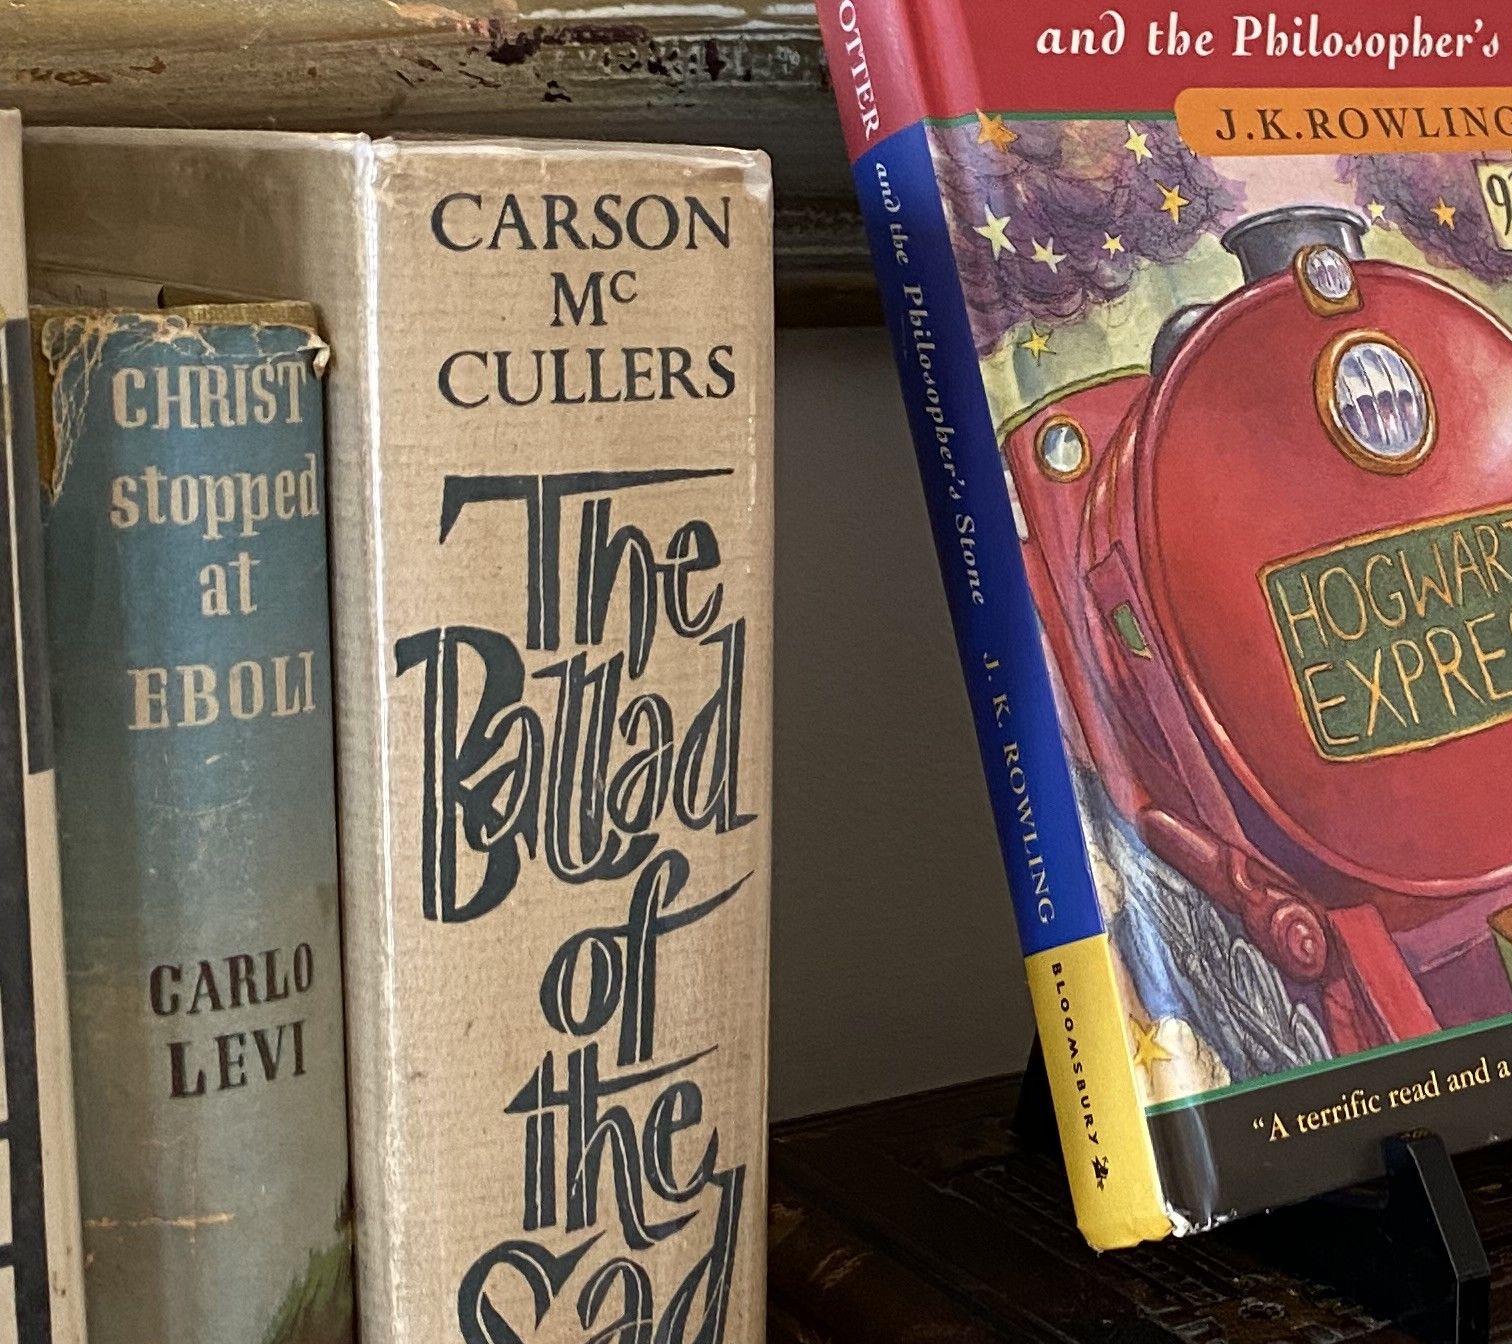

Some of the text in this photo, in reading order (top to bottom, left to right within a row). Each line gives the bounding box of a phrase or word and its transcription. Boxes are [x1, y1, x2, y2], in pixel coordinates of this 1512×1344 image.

[1035, 10, 1127, 58] and
[1147, 14, 1214, 58] the
[1231, 11, 1500, 69] Philosopher's
[431, 193, 732, 251] CARSON
[112, 359, 308, 429] CHRIST
[438, 345, 736, 408] CULLERS
[876, 162, 984, 606] and the Philosopher's Stone
[111, 453, 320, 542] stopped
[200, 550, 258, 617] at
[440, 468, 734, 674] The
[128, 651, 316, 731] EBOLI
[397, 617, 758, 923] Ballad
[1003, 742, 1054, 926] ROWLING
[148, 940, 314, 1015] CARLO
[539, 849, 754, 1066] of
[169, 1020, 308, 1099] LEVI
[1051, 961, 1099, 1145] BLOOMSBURY
[1297, 1085, 1382, 1134] terrific
[1388, 1071, 1440, 1108] read
[1446, 1064, 1492, 1093] and
[1497, 1064, 1511, 1080] a
[504, 1045, 718, 1249] the
